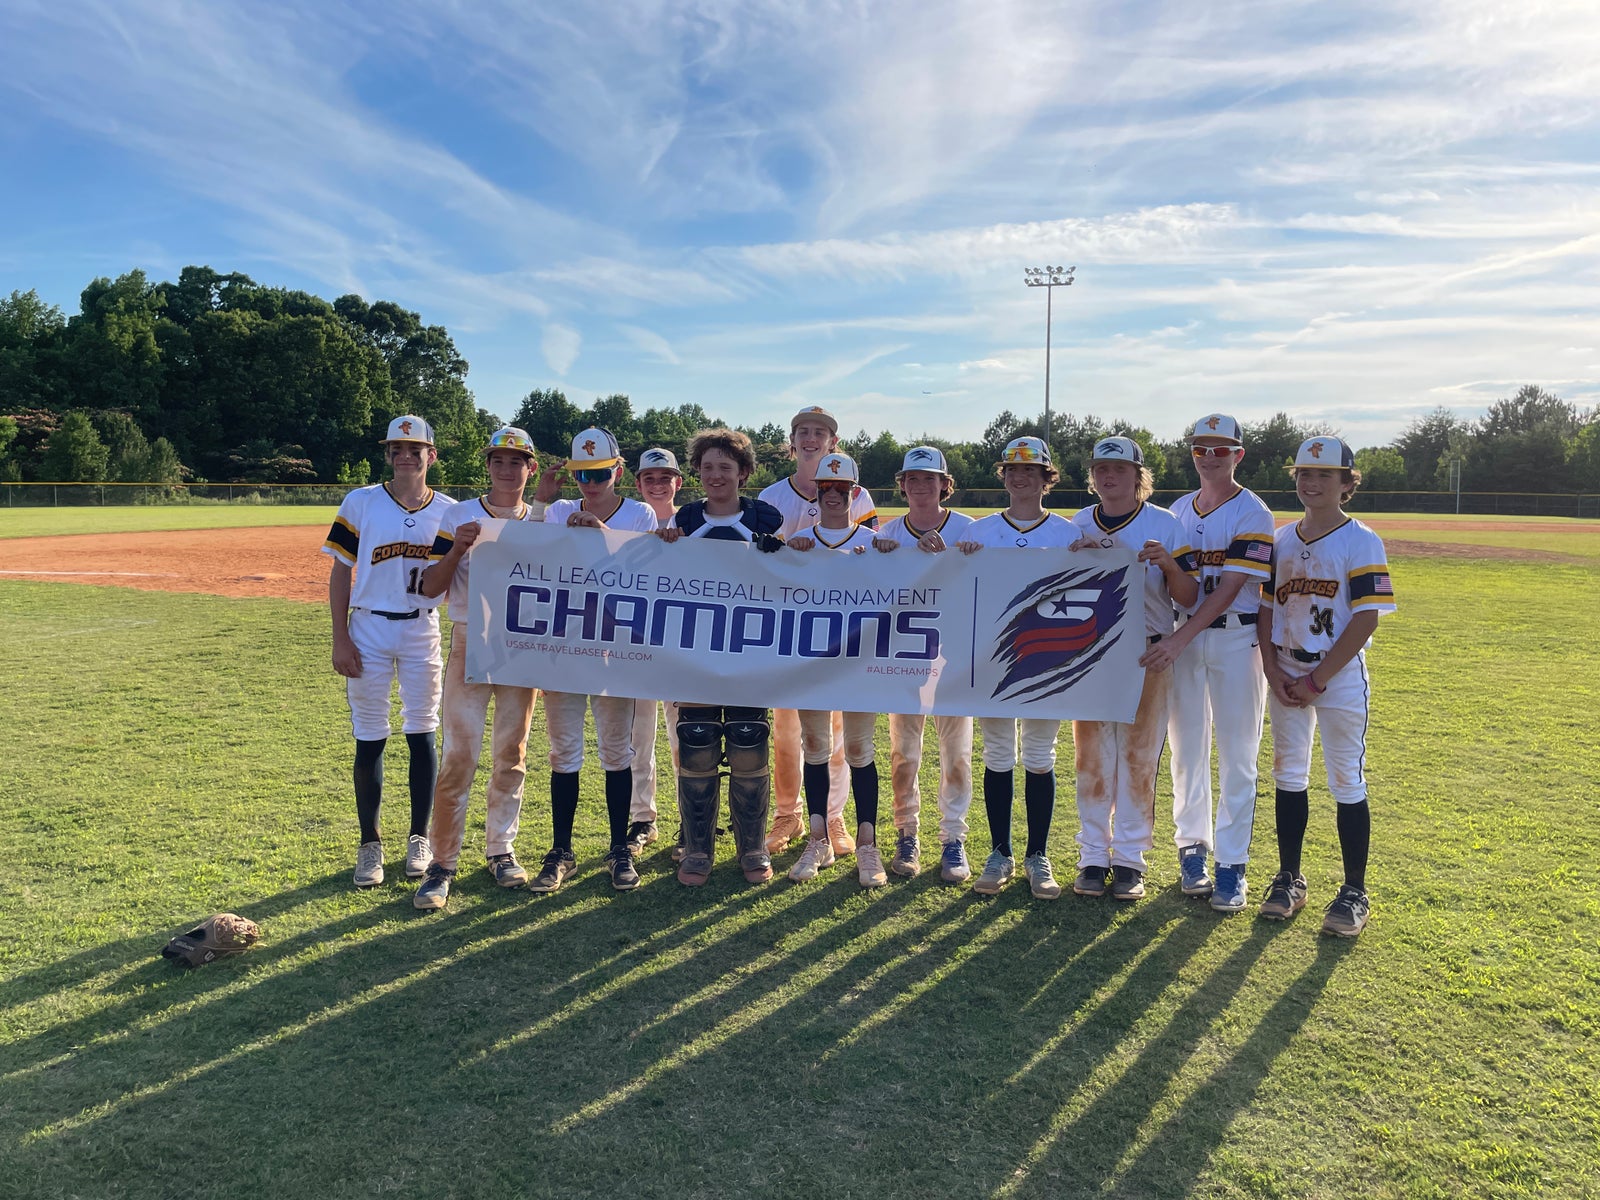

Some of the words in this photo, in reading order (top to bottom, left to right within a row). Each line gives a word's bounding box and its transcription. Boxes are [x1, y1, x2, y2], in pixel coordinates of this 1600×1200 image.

[406, 566, 425, 596] 1
[509, 562, 552, 582] ALL
[558, 566, 648, 591] LEAGUE
[656, 576, 774, 602] BASEBALL
[780, 586, 942, 606] TOURNAMENT
[505, 584, 941, 661] CHAMPIONS
[1309, 604, 1334, 638] 34
[505, 640, 653, 661] USSSATRAVELBASEBALL.COM
[866, 666, 939, 677] #ALBCHAMPS
